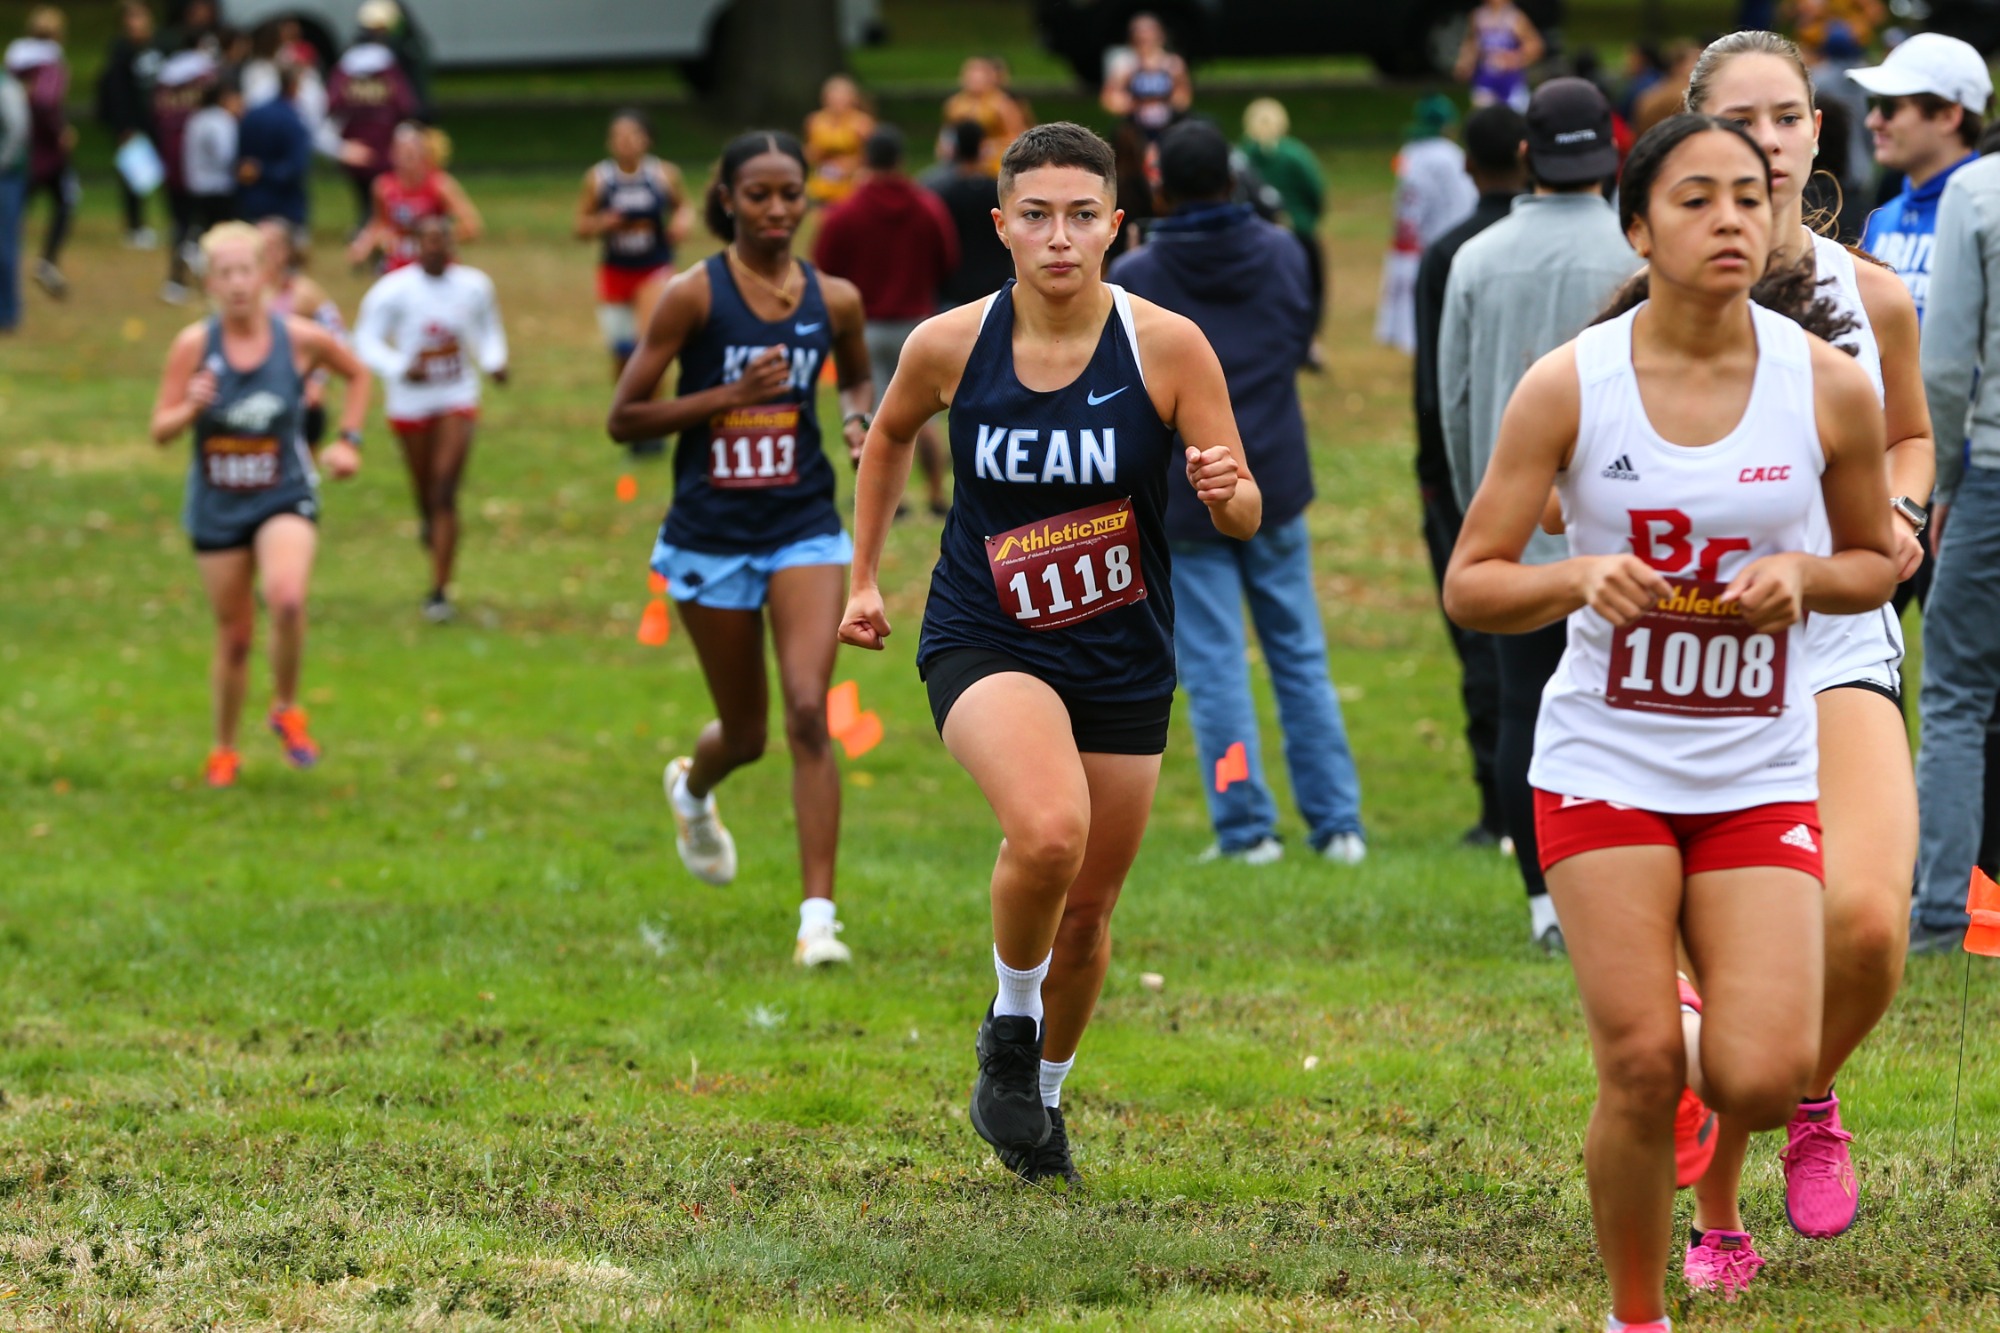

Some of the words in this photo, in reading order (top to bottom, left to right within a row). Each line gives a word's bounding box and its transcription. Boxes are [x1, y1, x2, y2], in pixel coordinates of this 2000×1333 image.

[711, 434, 796, 479] 1113
[975, 424, 1117, 484] KEAN
[1738, 465, 1792, 483] CACC
[1009, 544, 1133, 620] 1118
[1657, 585, 1741, 615] thletic
[1620, 627, 1776, 699] 1008
